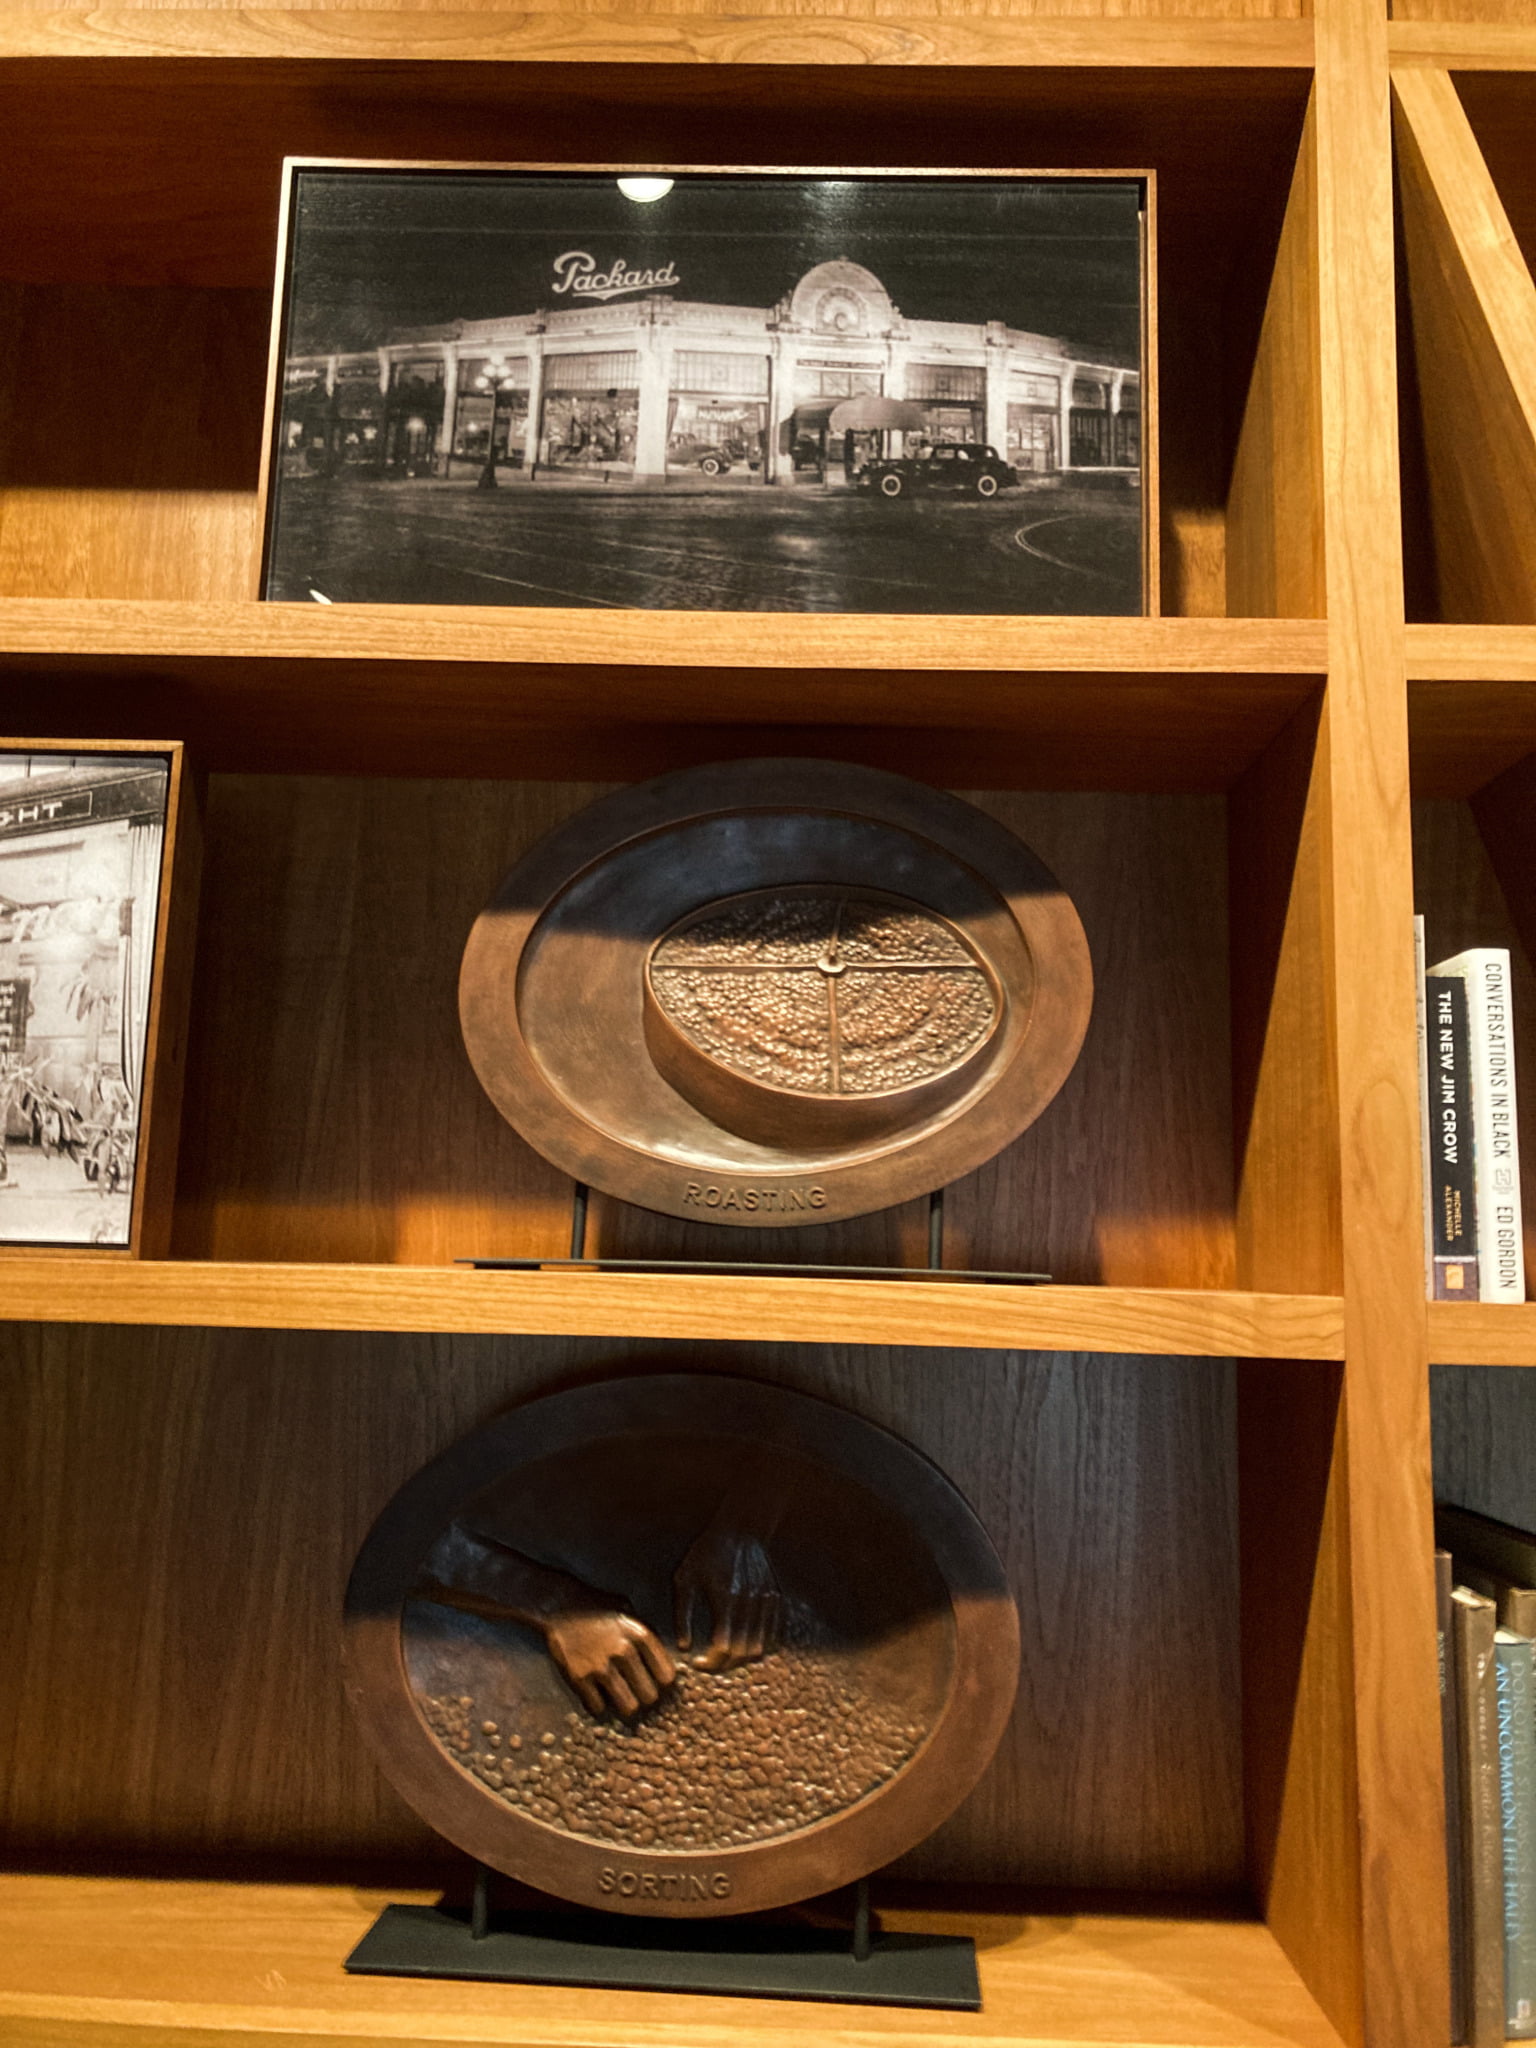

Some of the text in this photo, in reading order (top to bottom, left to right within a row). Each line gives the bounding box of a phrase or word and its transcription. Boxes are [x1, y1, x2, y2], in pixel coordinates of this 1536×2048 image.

[552, 250, 681, 300] Packard
[1437, 991, 1458, 1164] THE NEW JIM CROW
[1484, 963, 1512, 1159] CONVERSATIONS IN BLACK
[683, 1181, 828, 1212] ROASTING
[1444, 1185, 1455, 1241] ALEXANDER
[1453, 1190, 1464, 1236] MICHELLE
[1496, 1206, 1517, 1290] ED GORDON
[1495, 1662, 1511, 1692] AN
[1511, 1660, 1531, 1768] DOROTHY
[1497, 1698, 1517, 1831] UNCOMMON
[598, 1866, 733, 1902] SORTING
